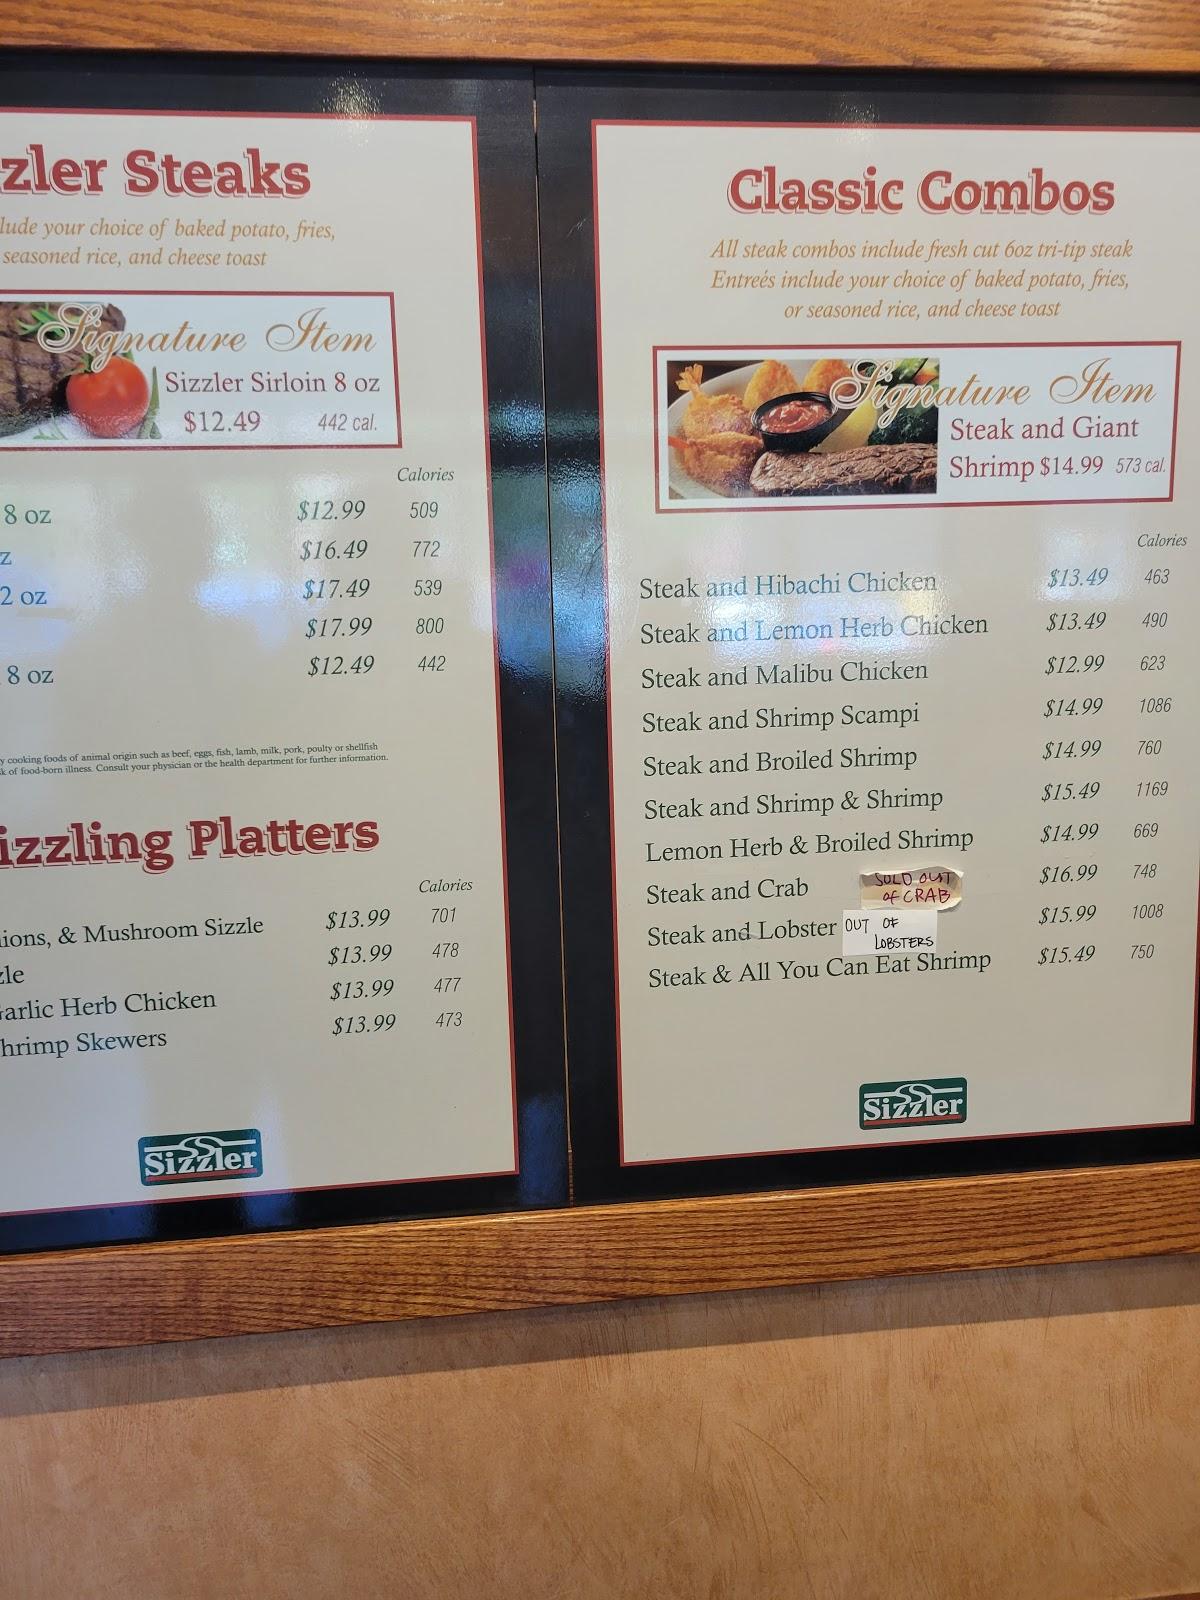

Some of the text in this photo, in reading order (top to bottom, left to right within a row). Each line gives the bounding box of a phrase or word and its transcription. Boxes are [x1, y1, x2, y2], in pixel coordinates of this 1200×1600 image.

[0, 144, 310, 199] zler Steaks
[727, 166, 1114, 215] Classic Combos
[0, 216, 334, 243] lude your choice baked potato, fries,
[3, 246, 267, 268] seasoned rice, cheese toast
[710, 239, 1133, 262] All steak combos include fresh cut 6oz tri-tip steak
[781, 269, 844, 288] include
[847, 275, 890, 293] your
[894, 269, 946, 288] choice
[975, 269, 1025, 288] baked
[1026, 272, 1084, 292] potato,
[1088, 268, 1128, 291] fries,
[807, 298, 1061, 320] seasoned rice, cheese toast
[38, 304, 377, 373] Signature Item
[166, 372, 380, 392] Sizzler Sirloin 8 oz
[829, 358, 1157, 427] Signature Item
[184, 410, 260, 434] $12.49
[318, 413, 347, 431] 442
[951, 416, 1139, 440] Steak Giant
[398, 467, 454, 481] Calories
[950, 455, 1141, 482] Shrimp 573
[1040, 456, 1103, 477] $14.99
[297, 500, 365, 522] $12.99
[410, 502, 438, 518] 509
[300, 540, 368, 561] $16.49
[413, 541, 440, 557] 772
[1138, 533, 1187, 547] Calories
[640, 571, 937, 599] Steak Hibachi Chicken
[1047, 568, 1108, 589] $13.49
[1144, 569, 1170, 584] 463
[303, 579, 370, 600] $17.49
[414, 580, 442, 596] 539
[305, 617, 372, 639] $17.99
[416, 618, 444, 634] 800
[641, 614, 988, 644] Steak Lemon Herb Chicken
[1046, 612, 1106, 632] $13.49
[1142, 612, 1167, 628] 490
[308, 656, 374, 677] $12.49
[418, 656, 445, 671] 442
[1045, 655, 1104, 675] $12.99
[1141, 655, 1165, 671] 623
[642, 660, 928, 688] Steak Malibu Chicken
[1044, 698, 1103, 718] $14.99
[1141, 698, 1172, 713] 1086
[643, 702, 919, 732] Steak Shrimp Scampi
[8, 742, 378, 765] cooking animal beef, poulty shellfish
[1042, 740, 1101, 760] $14.99
[1138, 740, 1162, 755] 760
[21, 753, 388, 775] food-born Consult physician health department information.
[644, 747, 917, 776] Steak Broiled Shrimp
[1042, 782, 1100, 802] $15.49
[1137, 781, 1168, 797] 1169
[645, 788, 943, 819] Steak Shrimp Shrimp
[186, 816, 379, 860] Platters
[1040, 823, 1098, 844] $14.99
[1134, 823, 1158, 838] 669
[646, 829, 973, 862] Lemon Herb Broiled Shrimp
[875, 871, 954, 887] SOLD OUT
[1040, 864, 1097, 885] $16.99
[1134, 864, 1157, 879] 748
[419, 879, 472, 893] Calories
[647, 877, 808, 904] Steak Crab
[905, 887, 952, 904] CRAB
[326, 909, 390, 931] $13.99
[432, 908, 455, 923] 701
[1039, 905, 1096, 925] $15.99
[1134, 904, 1164, 919] 1008
[83, 917, 263, 943] Mushroom Sizzle
[648, 920, 837, 946] Steak Lobster
[845, 917, 899, 934] OUT OF
[432, 943, 459, 958] 478
[875, 934, 934, 950] LOBSTERS
[1131, 944, 1154, 959] 750
[328, 944, 392, 966] $13.99
[1038, 945, 1095, 966] $15.49
[649, 951, 991, 987] Steak All You Can Eat Shrimp
[330, 979, 394, 1001] $13.99
[434, 977, 461, 992] 477
[60, 991, 216, 1016] Herb Chicken
[333, 1014, 396, 1036] $13.99
[436, 1012, 462, 1027] 473
[77, 1033, 167, 1051] Skewers
[864, 1095, 963, 1121] Sizzler
[145, 1146, 257, 1177] Sizzler
